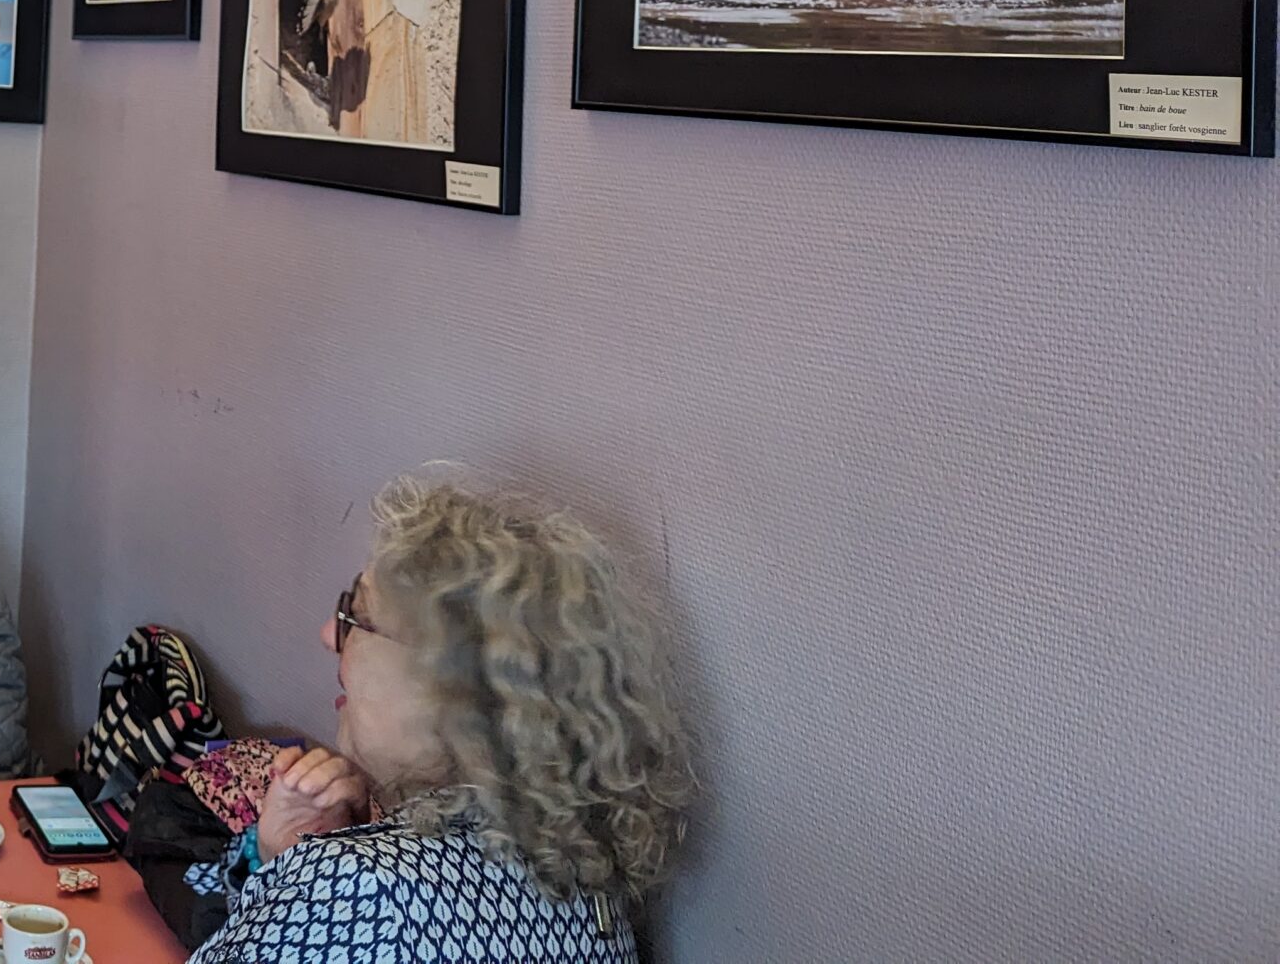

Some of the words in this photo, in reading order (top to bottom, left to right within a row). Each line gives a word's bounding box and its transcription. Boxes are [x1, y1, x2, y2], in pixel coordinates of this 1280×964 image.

[1118, 86, 1141, 94] Auteur
[1146, 87, 1180, 96] Jean-Luc
[1182, 88, 1219, 98] KESTER
[1119, 103, 1135, 111] Titre
[1139, 103, 1155, 113] bain
[1157, 105, 1166, 113] de
[1168, 106, 1187, 115] boue
[1118, 121, 1134, 129] Lieu
[1138, 122, 1167, 133] sanglier
[1169, 123, 1186, 133] forêt
[1188, 125, 1227, 136] vosgienne
